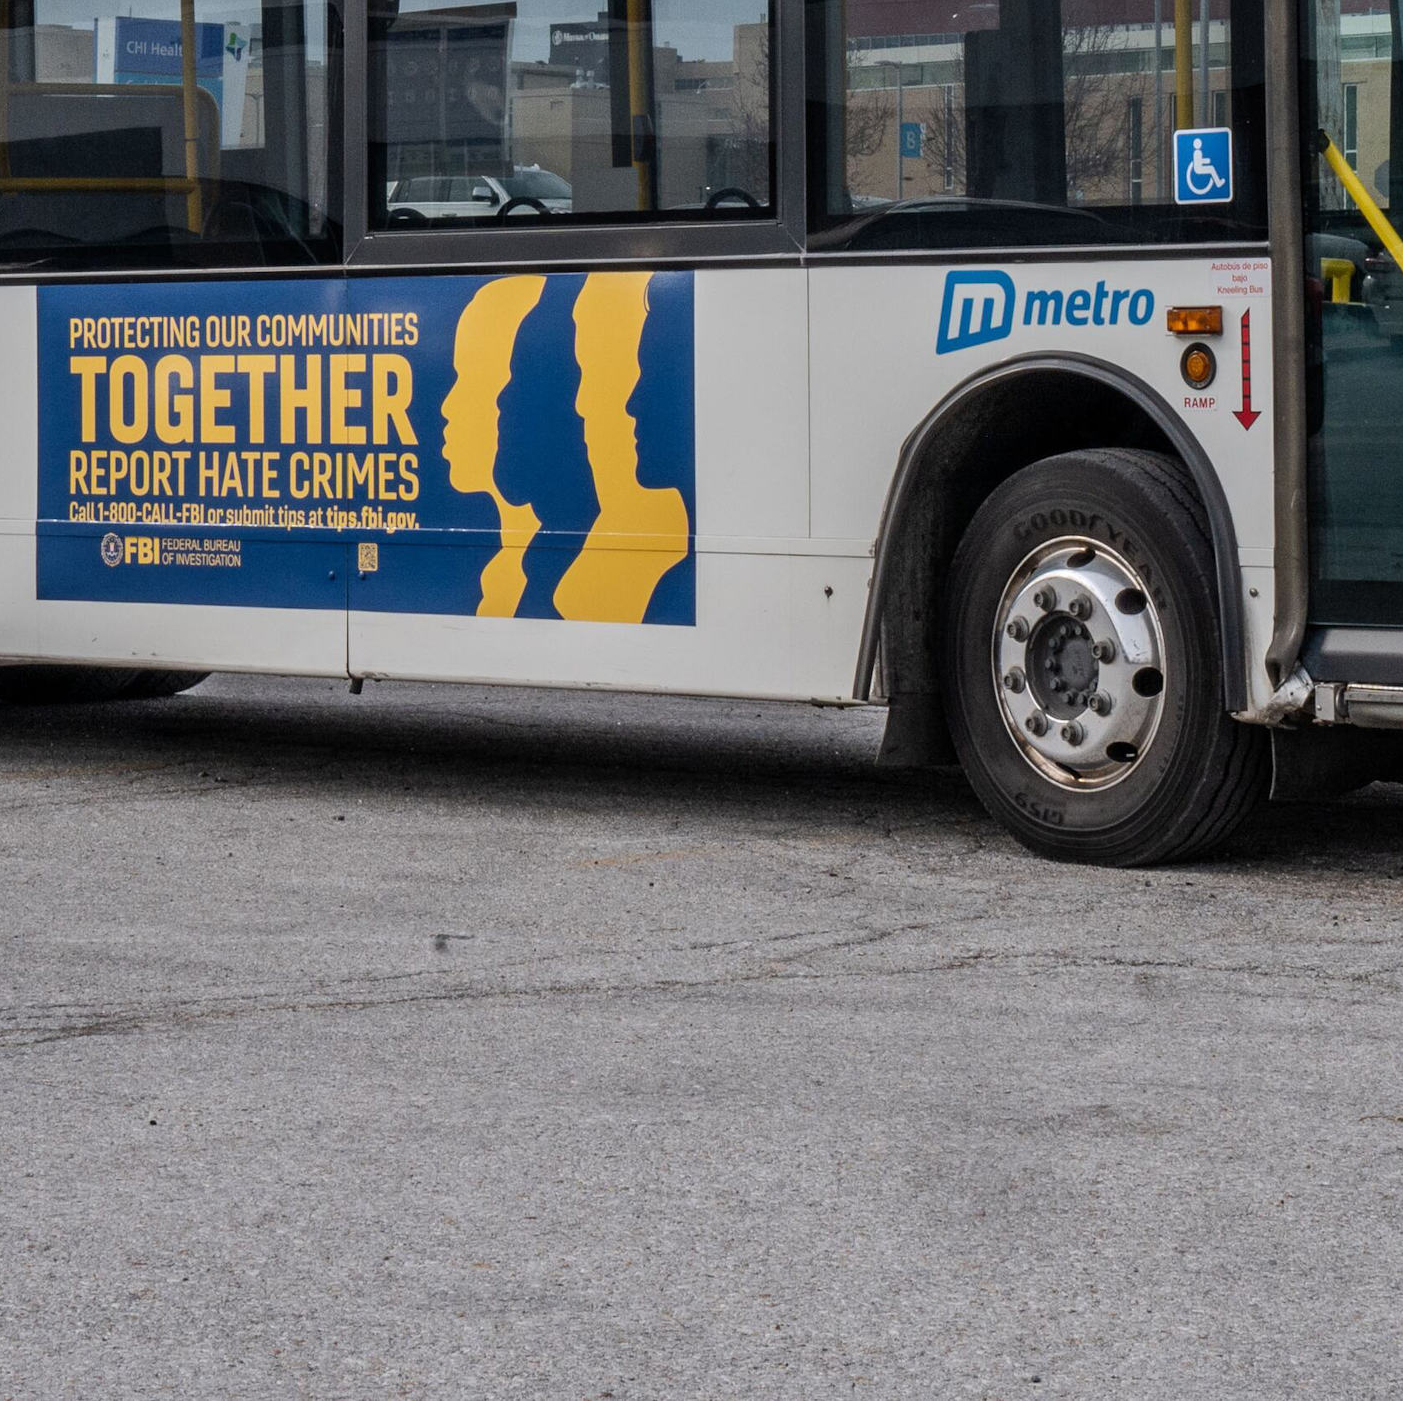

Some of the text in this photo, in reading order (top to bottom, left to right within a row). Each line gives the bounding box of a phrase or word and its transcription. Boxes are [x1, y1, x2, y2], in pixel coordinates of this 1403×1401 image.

[126, 40, 183, 57] CHI Healt
[1253, 262, 1269, 271] piso
[1232, 274, 1248, 283] bajo
[1217, 285, 1264, 295] Kneeling Bus
[1022, 280, 1155, 326] metro
[69, 312, 419, 348] PROTECTING OUR COMMUNITIES
[69, 354, 419, 445] TOGETHER
[1184, 397, 1216, 408] RAMP
[69, 450, 420, 502] REPORT HATE CRIMES
[69, 501, 420, 535] Call 1-800-CALL-FBI or submit tips at tips.fbi.gov.
[124, 536, 161, 565] FBI
[161, 538, 241, 553] FEDERAL BUREAU
[161, 552, 242, 567] OF INVESTIGATION
